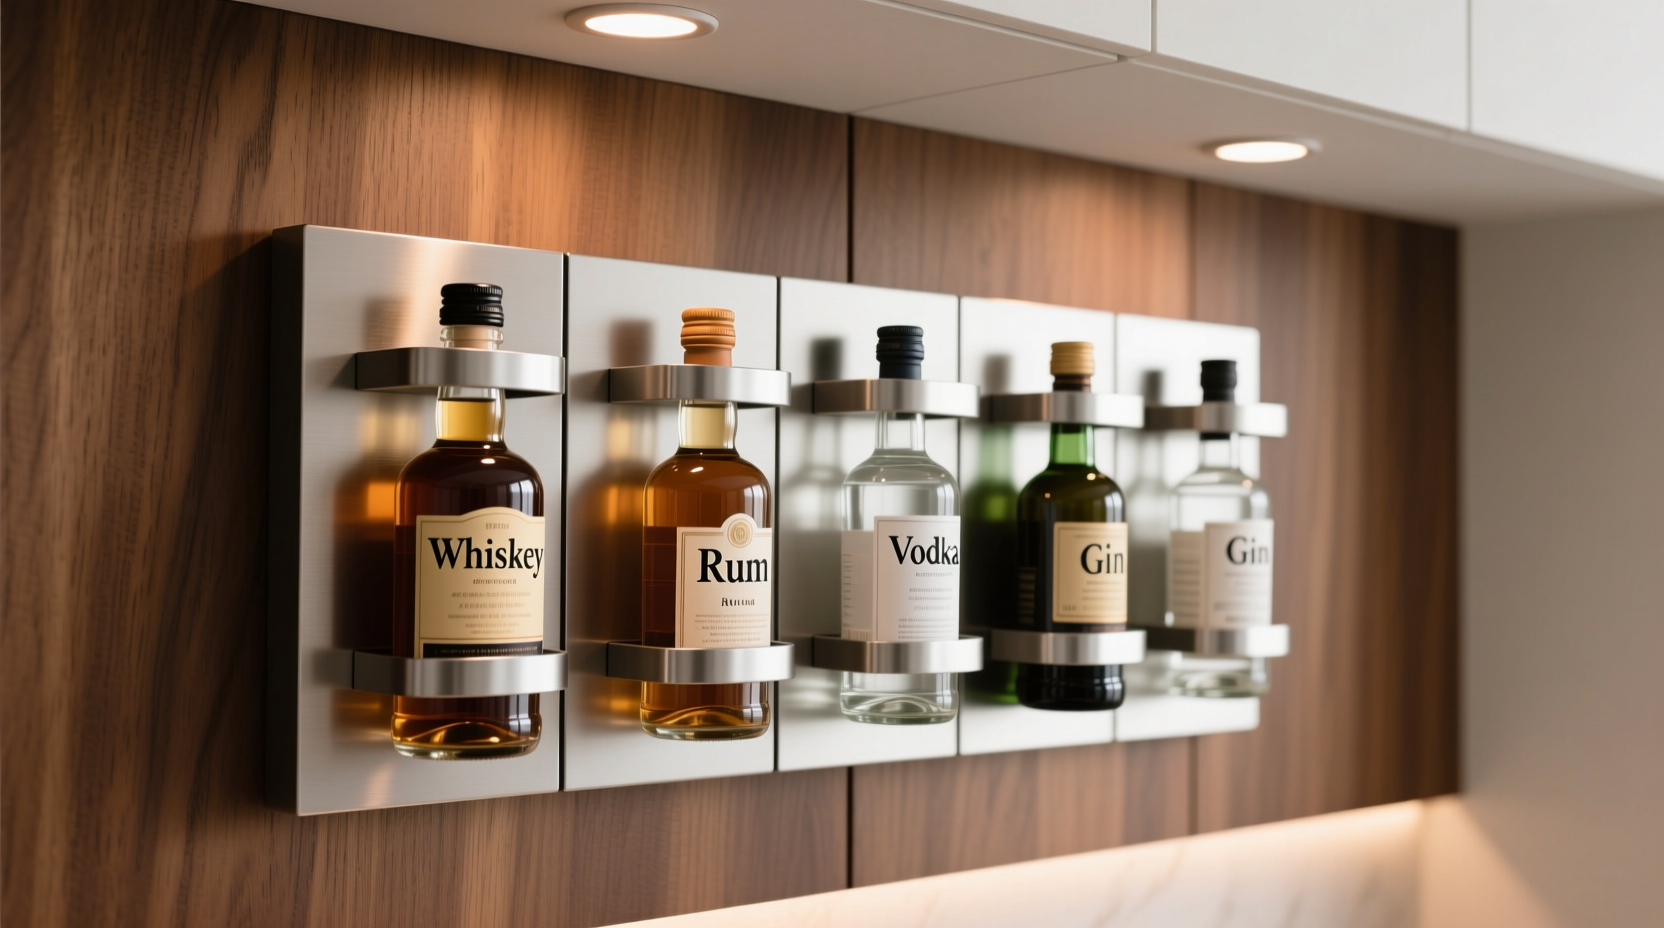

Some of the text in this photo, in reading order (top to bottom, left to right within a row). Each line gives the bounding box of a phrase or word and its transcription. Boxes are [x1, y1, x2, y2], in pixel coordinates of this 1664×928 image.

[427, 536, 544, 579] Whiskey
[697, 548, 768, 584] Rum
[888, 535, 960, 565] Vodka
[1080, 543, 1124, 575] Gin
[1226, 536, 1268, 566] Gin
